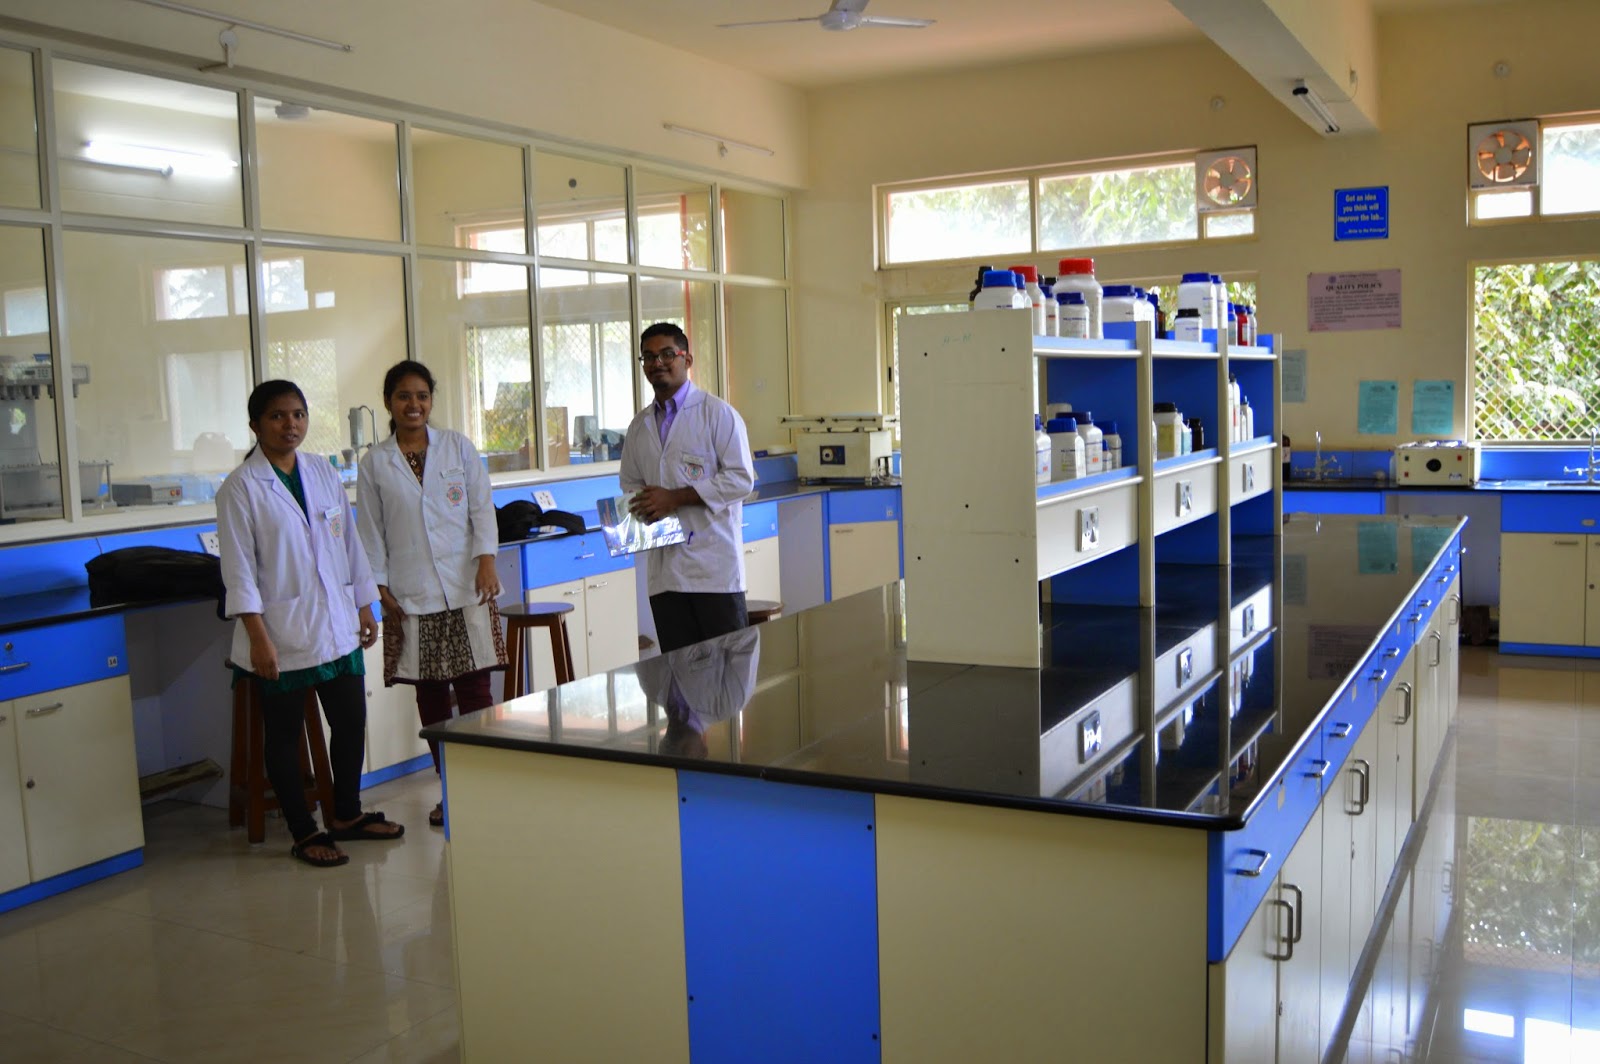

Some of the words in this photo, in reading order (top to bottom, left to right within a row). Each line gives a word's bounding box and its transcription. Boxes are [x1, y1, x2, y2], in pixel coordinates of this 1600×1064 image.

[1365, 193, 1376, 201] idea
[1343, 206, 1352, 214] you
[1369, 202, 1379, 210] will
[1337, 215, 1359, 223] improve
[1361, 213, 1369, 221] the
[1326, 284, 1355, 292] QUALITY
[1358, 281, 1382, 289] POLICY
